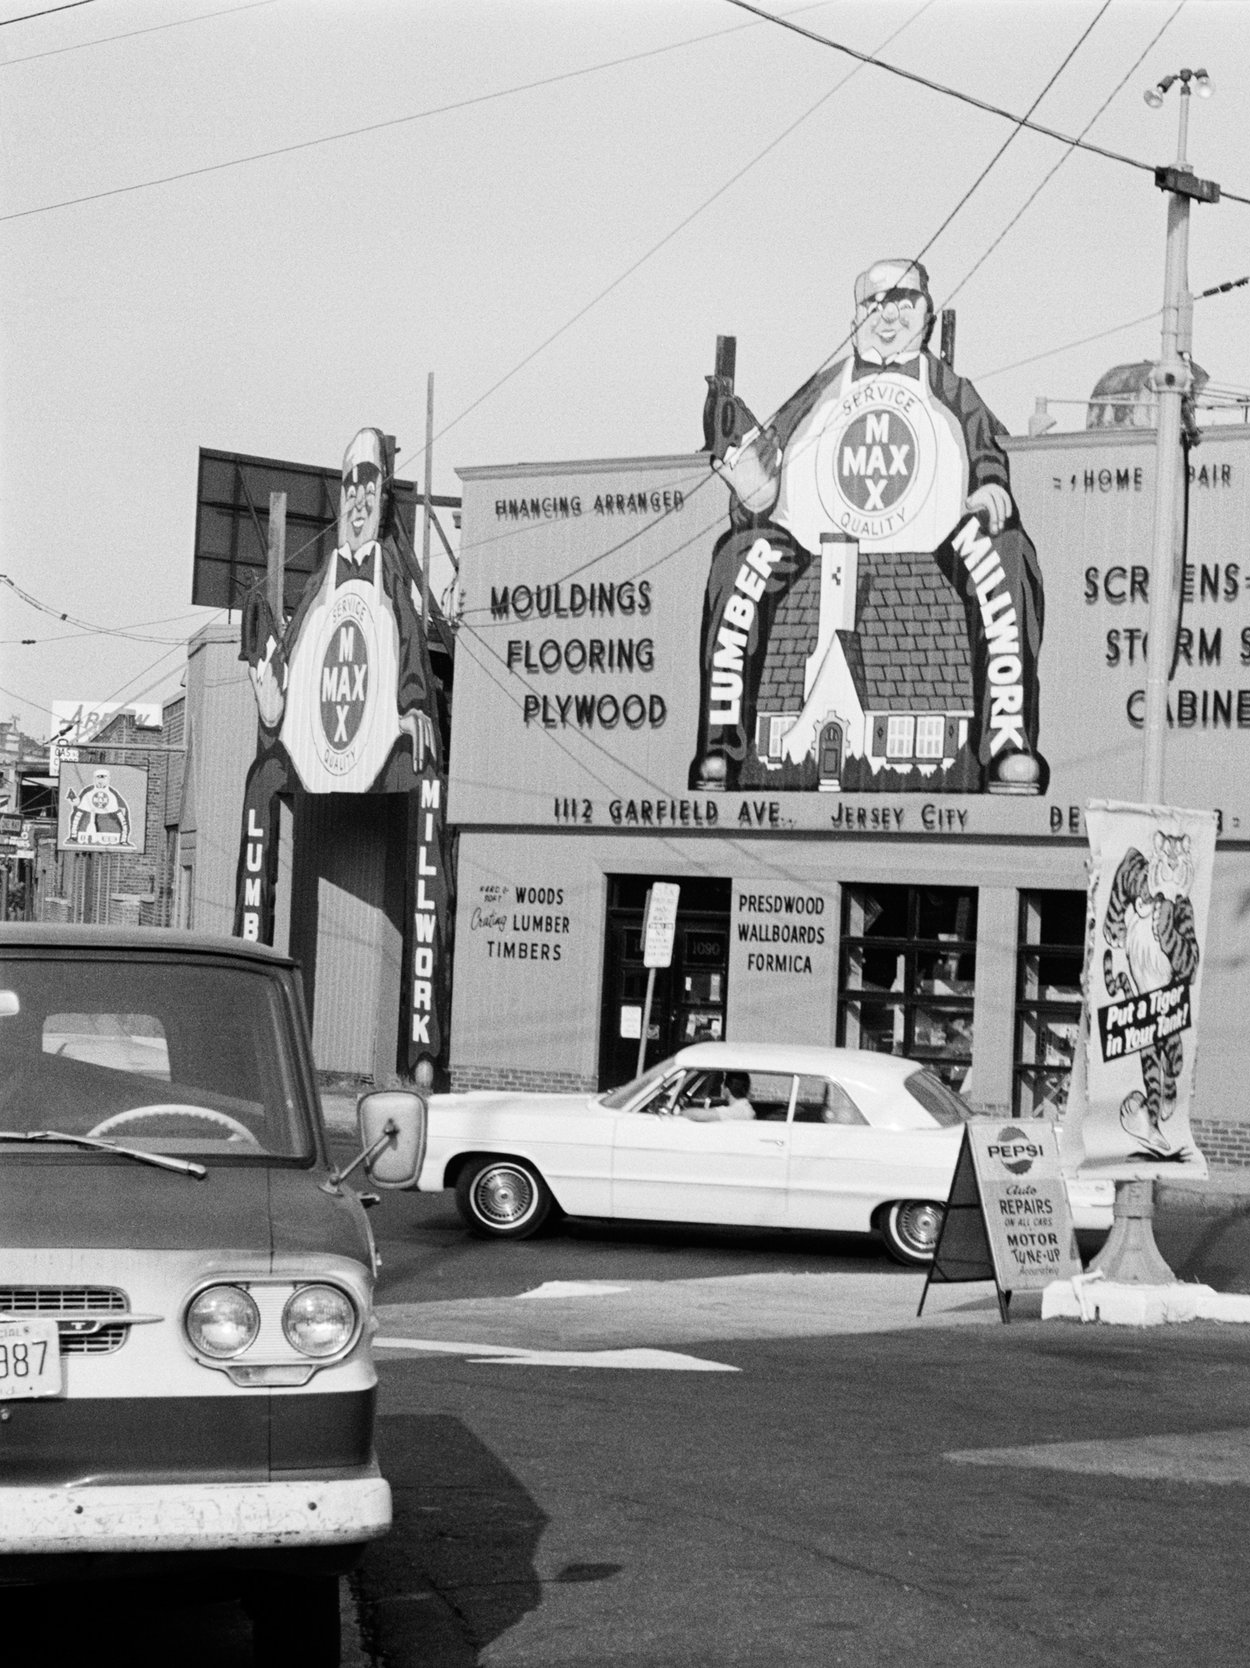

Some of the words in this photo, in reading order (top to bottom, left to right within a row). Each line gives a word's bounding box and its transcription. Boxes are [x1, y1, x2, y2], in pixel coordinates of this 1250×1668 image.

[842, 386, 915, 415] SERVICE
[842, 444, 910, 477] MAX
[1084, 467, 1143, 490] HOME
[1186, 464, 1231, 488] PAIR
[495, 496, 582, 518] FINANCING
[593, 490, 685, 514] ARRANGED
[841, 507, 906, 536] QUALITY
[332, 599, 366, 623] SERVICE
[491, 580, 652, 618] MOULDINGS
[709, 538, 782, 725] LUMBER
[951, 517, 1024, 755] MILLWORK
[1106, 627, 1222, 665] STRM
[507, 638, 655, 671] FLOORING
[322, 664, 367, 702] MAX
[523, 693, 667, 727] PLYWOOD
[324, 749, 356, 771] QUALITY
[553, 799, 593, 823] 1112
[609, 799, 718, 826] GARFIELD
[831, 802, 904, 830] JERSEY
[921, 804, 968, 832] CITY
[242, 808, 264, 942] LUMB
[515, 887, 564, 905] WOODS
[739, 894, 825, 915] PRESDWOOD
[411, 779, 440, 1044] MILLWORK
[513, 914, 570, 933] LUMBER
[737, 923, 825, 945] WALLBOARDS
[487, 941, 562, 960] TIMBERS
[747, 952, 812, 973] FORMICA
[1106, 1002, 1136, 1031] Put
[1136, 1000, 1148, 1020] a
[1149, 984, 1185, 1016] Tiger
[1106, 1033, 1123, 1058] in
[1124, 1024, 1157, 1053] Your
[1156, 1002, 1189, 1038] Tank!
[987, 1144, 1044, 1158] PEPSI
[1000, 1198, 1053, 1216] REPAIRS
[1004, 1218, 1015, 1227] ON
[1017, 1217, 1030, 1227] ALL
[1033, 1217, 1053, 1227] CARS
[1007, 1233, 1058, 1247] MOTOR
